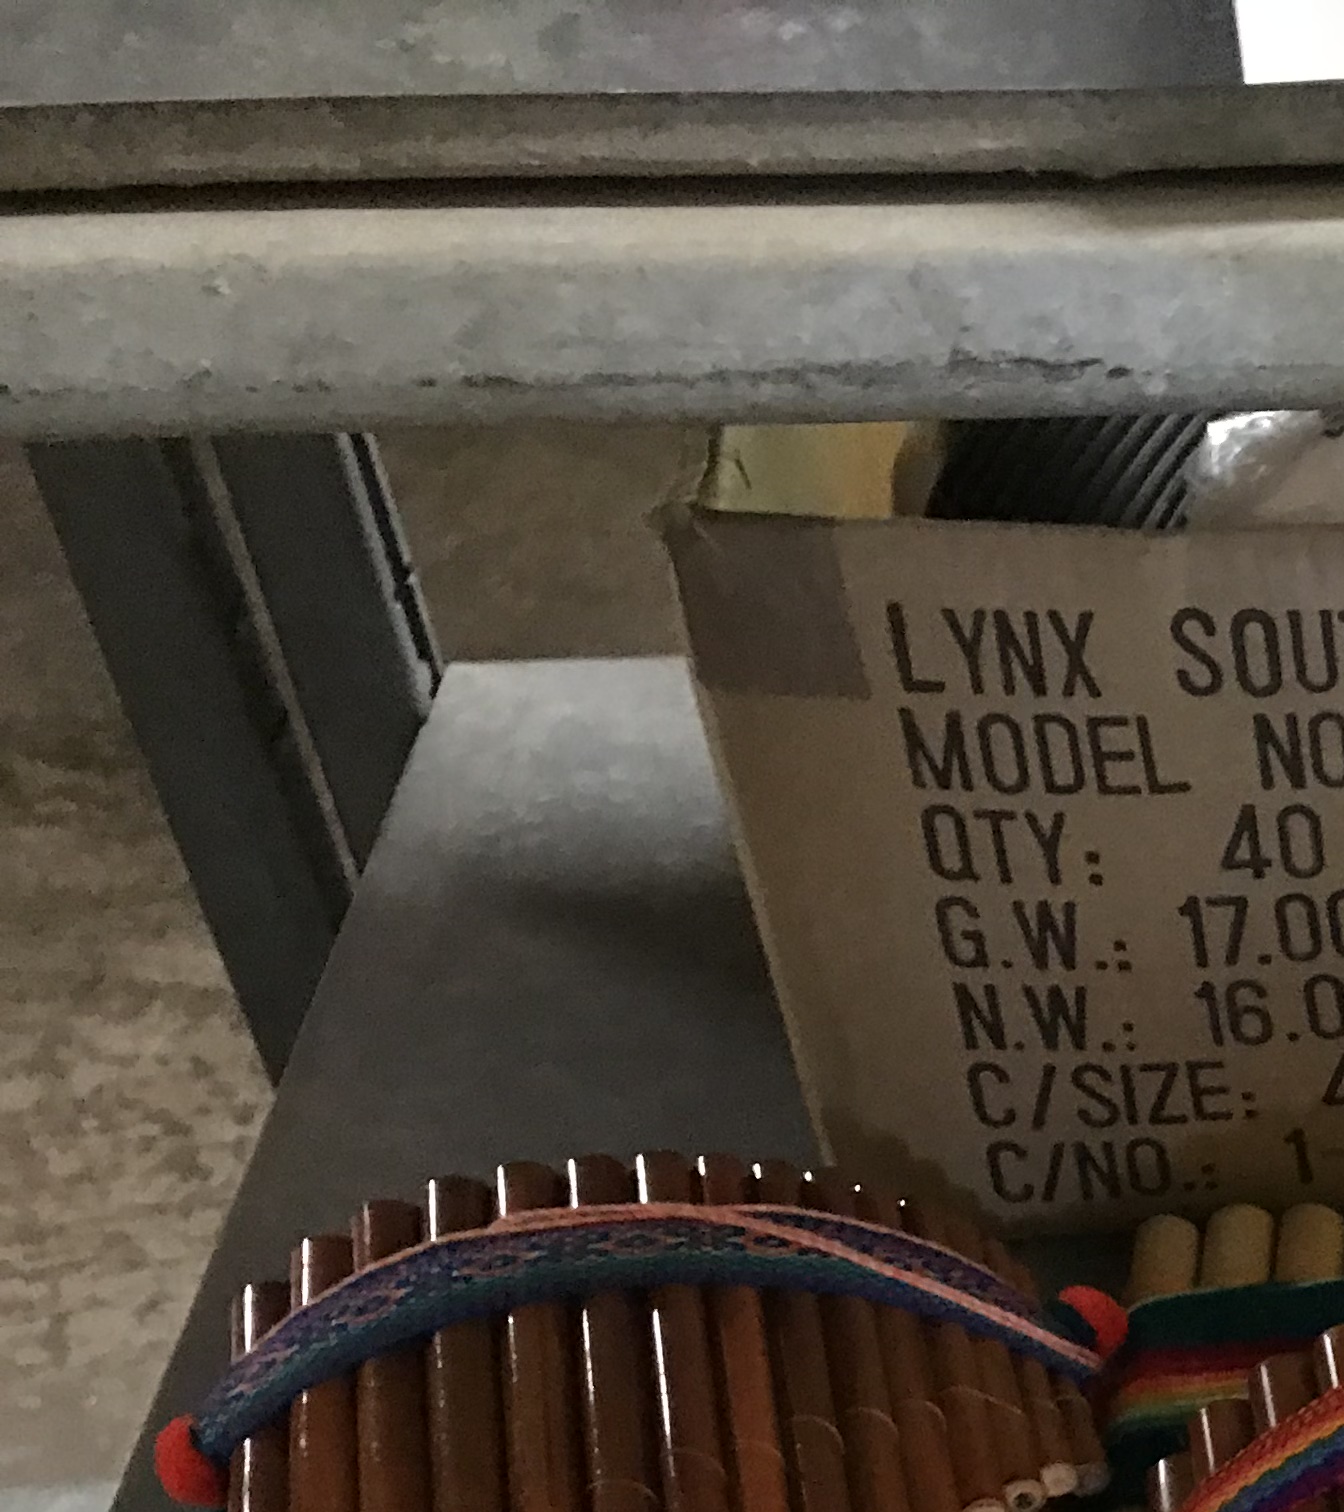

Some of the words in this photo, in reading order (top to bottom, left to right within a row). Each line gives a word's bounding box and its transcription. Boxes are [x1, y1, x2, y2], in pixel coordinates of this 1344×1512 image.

[886, 601, 1101, 698] LYNX
[897, 706, 1191, 795] MODEL
[920, 804, 1103, 885] QTY:
[1220, 804, 1325, 880] 40
[934, 895, 1132, 971] G.W.:
[952, 981, 1137, 1052] N.W.:
[966, 1061, 1259, 1132] C/SIZE:
[985, 1138, 1218, 1203] C/NO.:
